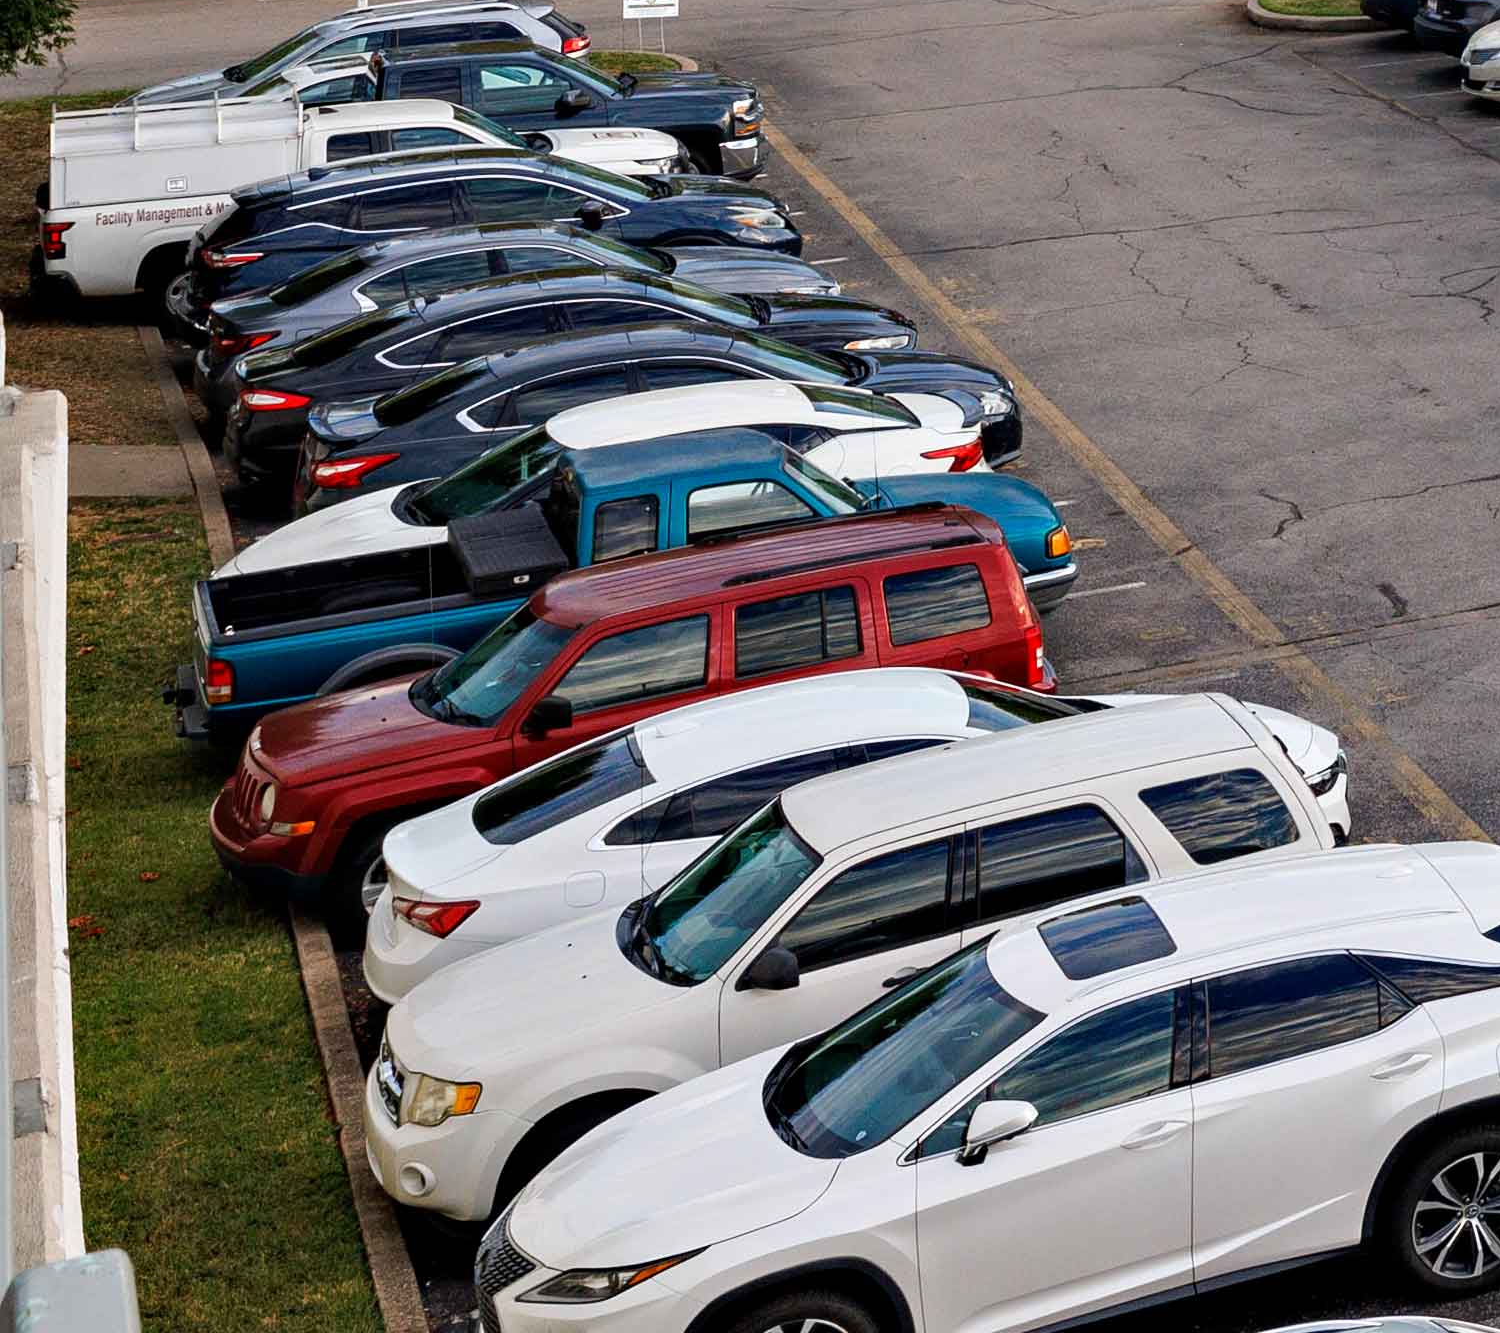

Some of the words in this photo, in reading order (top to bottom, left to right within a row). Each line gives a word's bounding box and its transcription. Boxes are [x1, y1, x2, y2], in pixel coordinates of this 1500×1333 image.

[95, 211, 133, 227] Facility
[136, 205, 203, 223] Management
[204, 203, 213, 216] &
